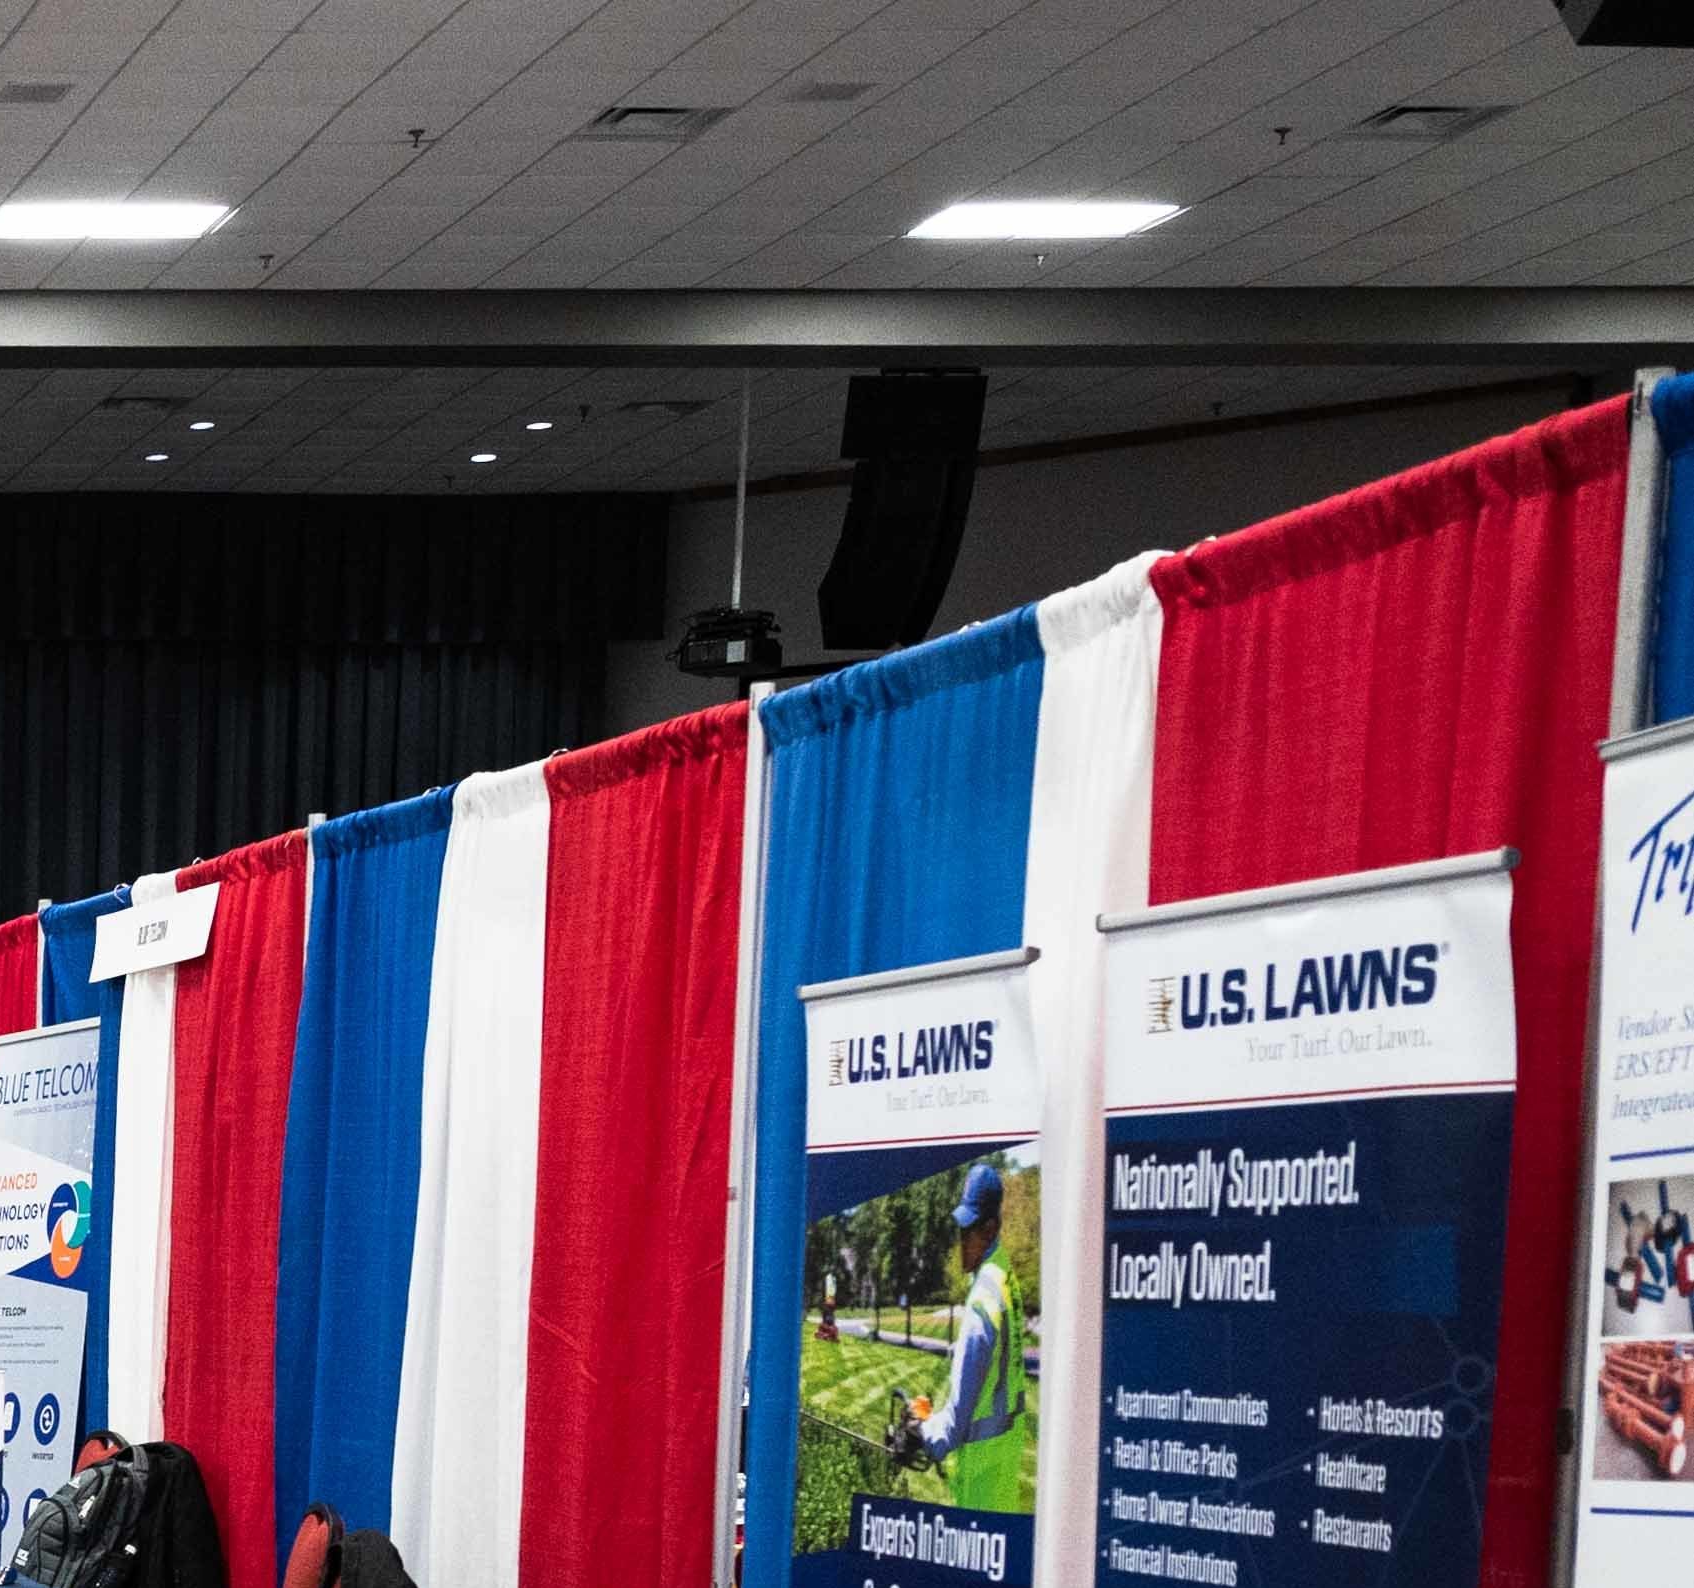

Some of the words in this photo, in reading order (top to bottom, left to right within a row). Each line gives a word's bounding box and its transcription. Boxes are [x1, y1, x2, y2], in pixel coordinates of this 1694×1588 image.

[1181, 968, 1254, 1030] U.S.
[1265, 943, 1438, 1021] LAWNS
[848, 1035, 891, 1084] U.S.
[897, 1020, 994, 1078] LAWNS
[1246, 1035, 1285, 1061] Your
[1290, 1033, 1332, 1060] Turf.
[1339, 1028, 1371, 1054] Our
[1375, 1024, 1433, 1051] Lawn.
[1113, 1148, 1225, 1217] Nationally
[1226, 1140, 1359, 1216] Supported.
[1109, 1241, 1187, 1309] Locally
[1189, 1239, 1276, 1301] Owned.
[1, 1306, 26, 1317] TELCOM
[1116, 1385, 1180, 1423] Apartment
[1181, 1389, 1268, 1427] Communities
[1319, 1395, 1362, 1433] Hotels
[1363, 1398, 1374, 1435] &
[1376, 1399, 1444, 1439] Resorts
[1114, 1436, 1149, 1471] Retail
[1151, 1439, 1160, 1472] &
[1162, 1440, 1199, 1475] Office
[1200, 1443, 1238, 1479] Parks
[1315, 1451, 1387, 1494] Healthcare
[1113, 1488, 1147, 1523] Home
[1149, 1491, 1189, 1527] Owner
[1190, 1495, 1275, 1537] Associations
[1313, 1508, 1393, 1552] Restaurants
[862, 1503, 916, 1560] Experts
[917, 1511, 932, 1564] In
[933, 1513, 1006, 1582] Growing
[1109, 1538, 1164, 1577] Financial
[1166, 1545, 1238, 1588] Institutions
